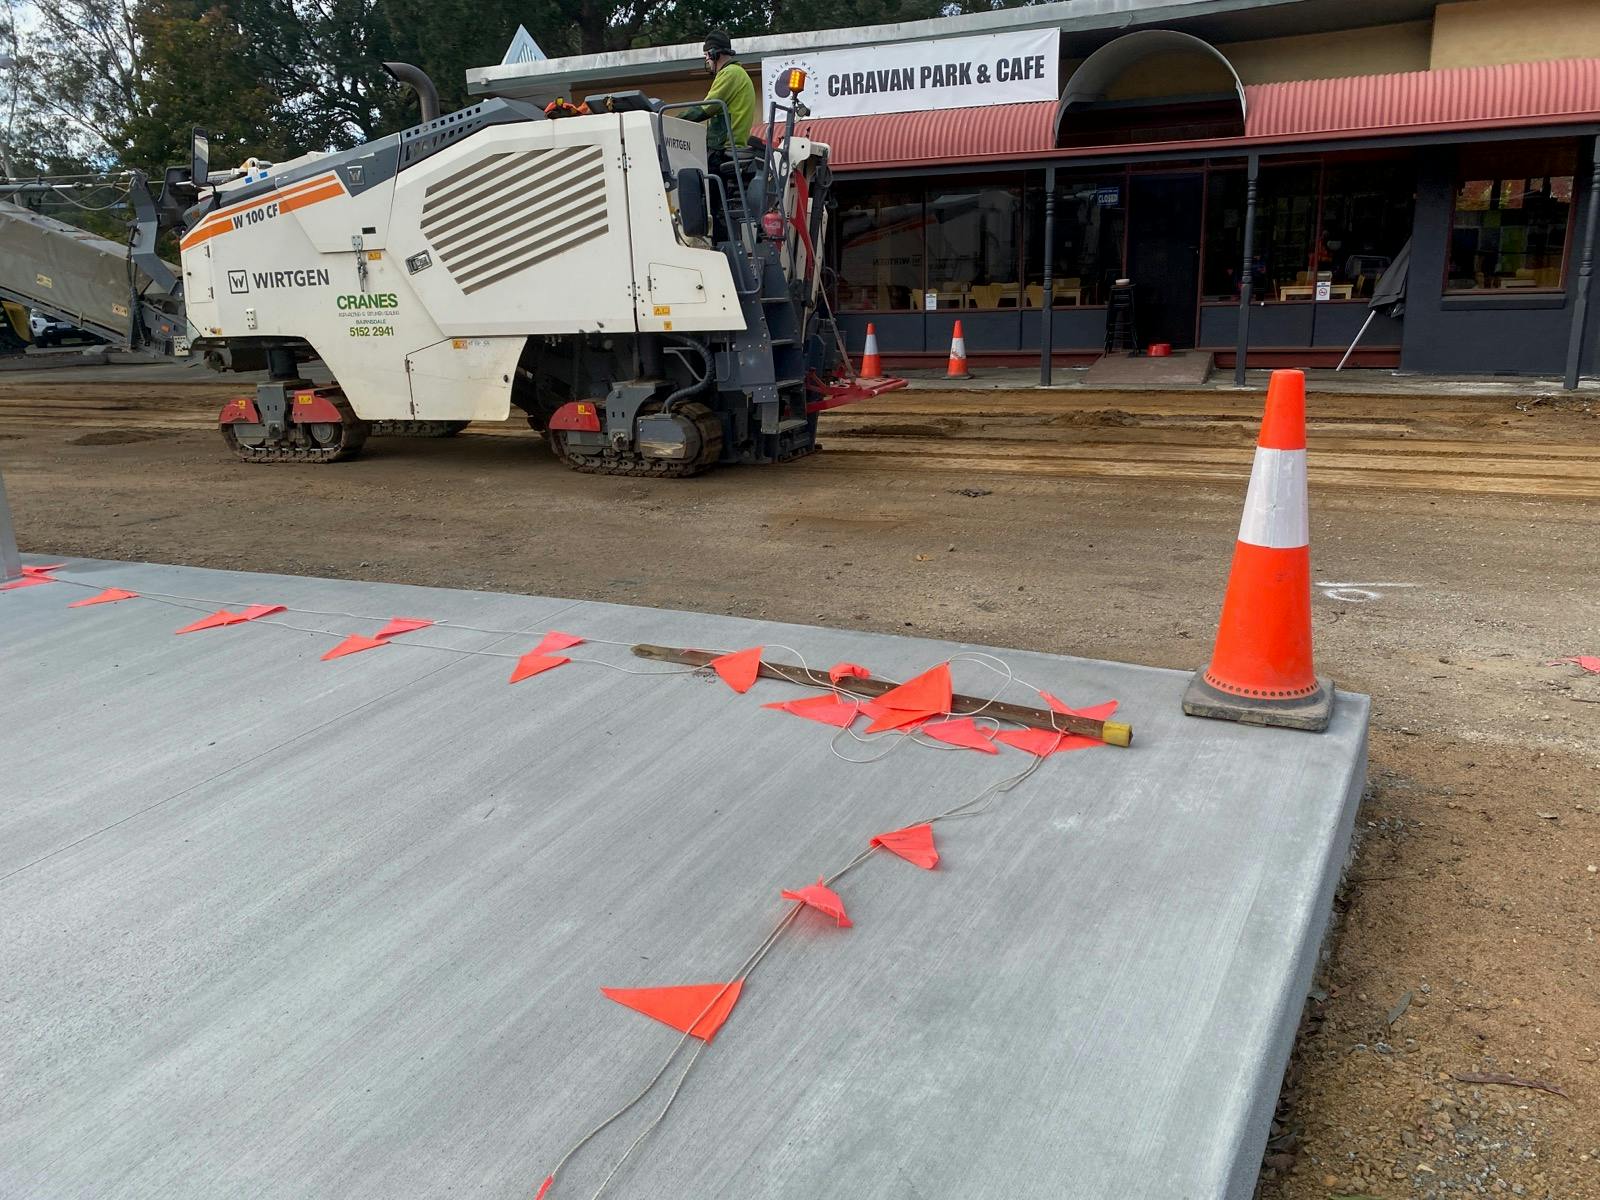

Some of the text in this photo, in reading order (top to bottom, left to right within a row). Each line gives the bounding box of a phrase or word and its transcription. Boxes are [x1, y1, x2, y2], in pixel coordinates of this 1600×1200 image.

[768, 59, 796, 99] MINGLING
[828, 55, 1045, 97] CARAVAN PARK & CAFE
[664, 136, 691, 151] WIRTGEN
[233, 203, 278, 229] W 100 CF
[252, 269, 330, 289] WIRTGEN
[336, 293, 399, 310] CRANES
[349, 326, 395, 337] 5152 2941
